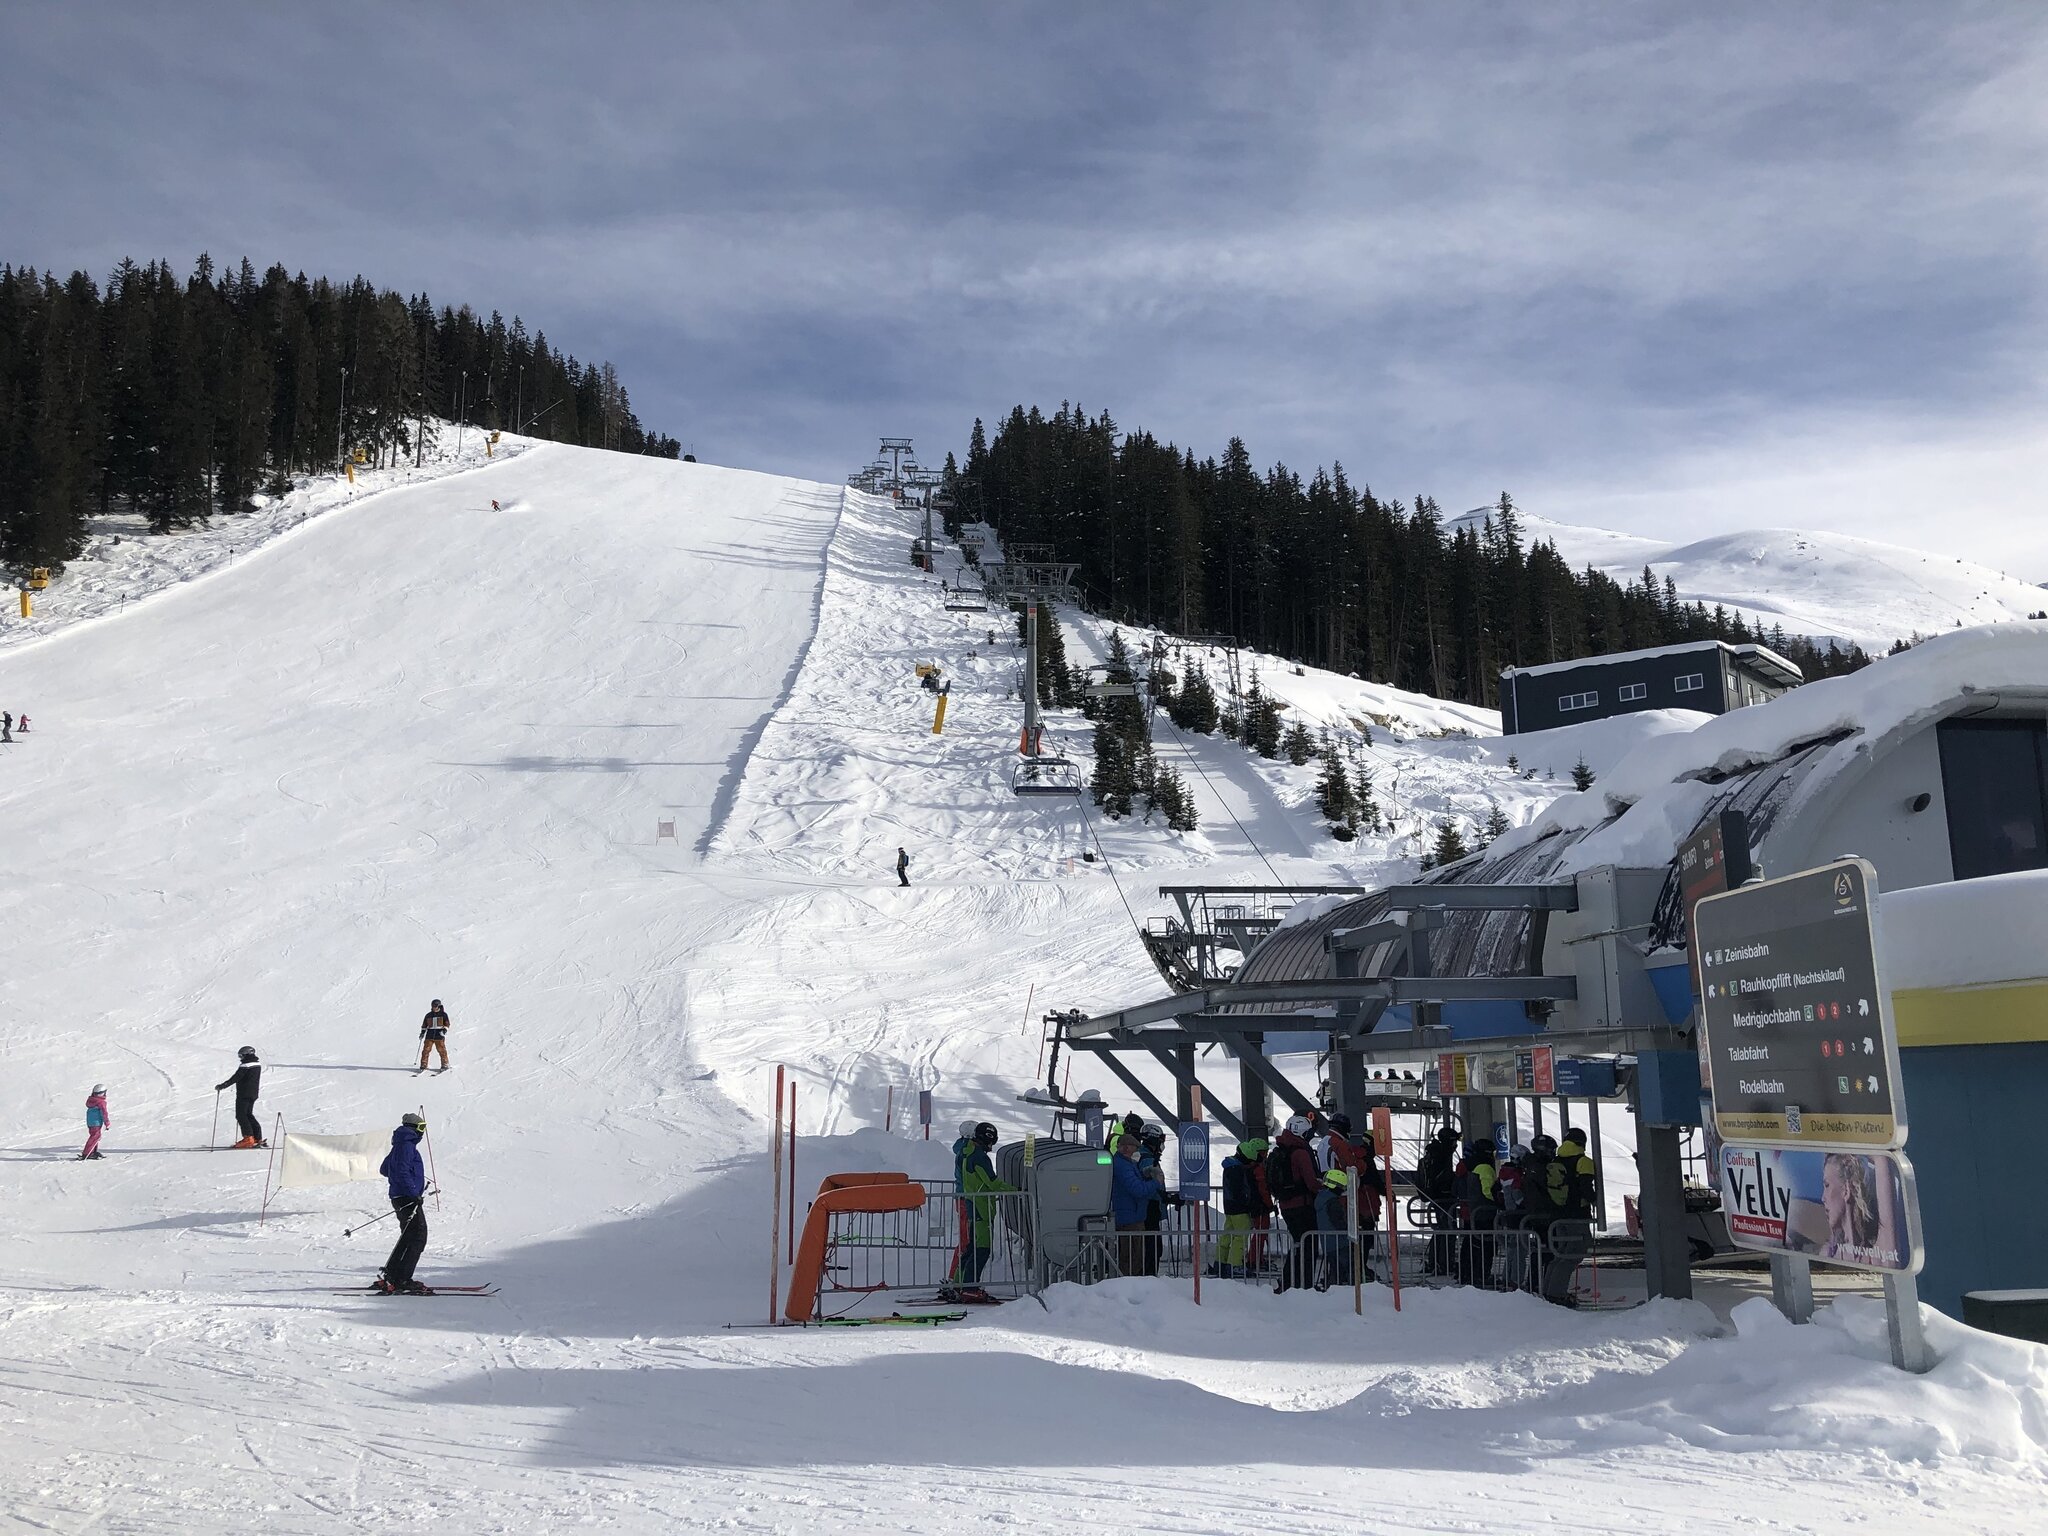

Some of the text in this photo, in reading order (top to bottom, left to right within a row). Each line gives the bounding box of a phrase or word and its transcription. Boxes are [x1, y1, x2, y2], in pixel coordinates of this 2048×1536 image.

[1724, 943, 1770, 963] Zeinisbahn
[1740, 966, 1845, 993] Rauhkopflift (Nachtskilauf)
[1732, 1007, 1801, 1029] Medrigjochbahn
[1727, 1045, 1770, 1062] Talabfahrt
[1739, 1078, 1786, 1095] Rodelbahn
[1836, 1242, 1900, 1263] www.velly.at
